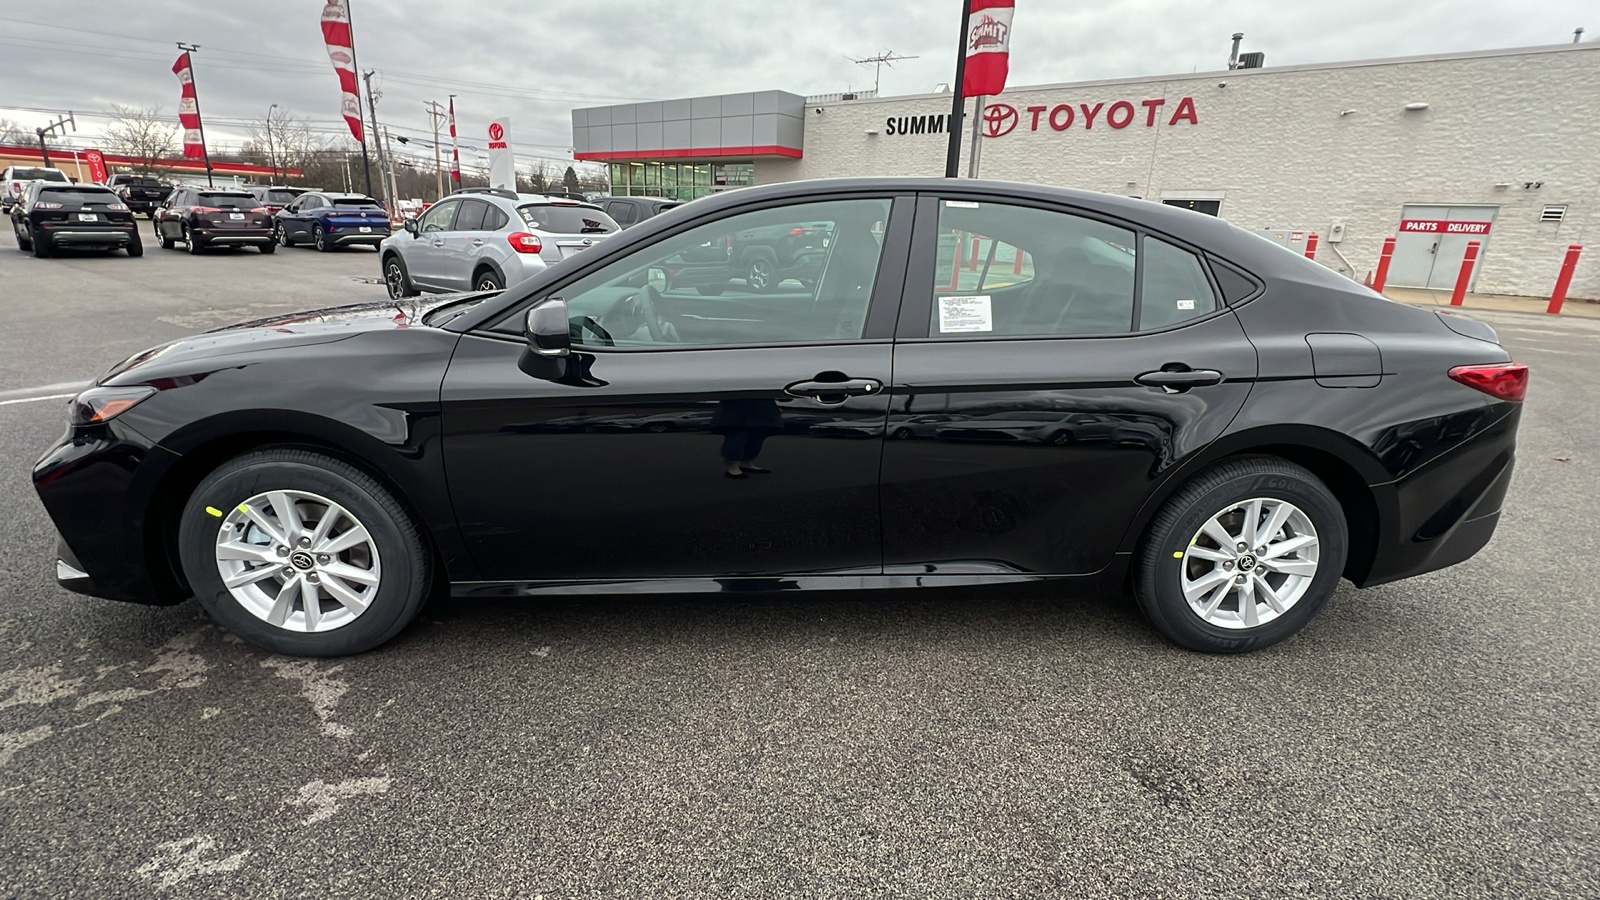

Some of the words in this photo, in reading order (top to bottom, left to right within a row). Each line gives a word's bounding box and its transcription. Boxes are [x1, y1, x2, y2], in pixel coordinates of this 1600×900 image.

[969, 21, 1007, 49] SUMMIT
[886, 114, 966, 135] SUMMI
[1027, 97, 1198, 131] TOYOTA
[1406, 222, 1438, 231] PARTS
[1447, 223, 1487, 233] DELIVERY
